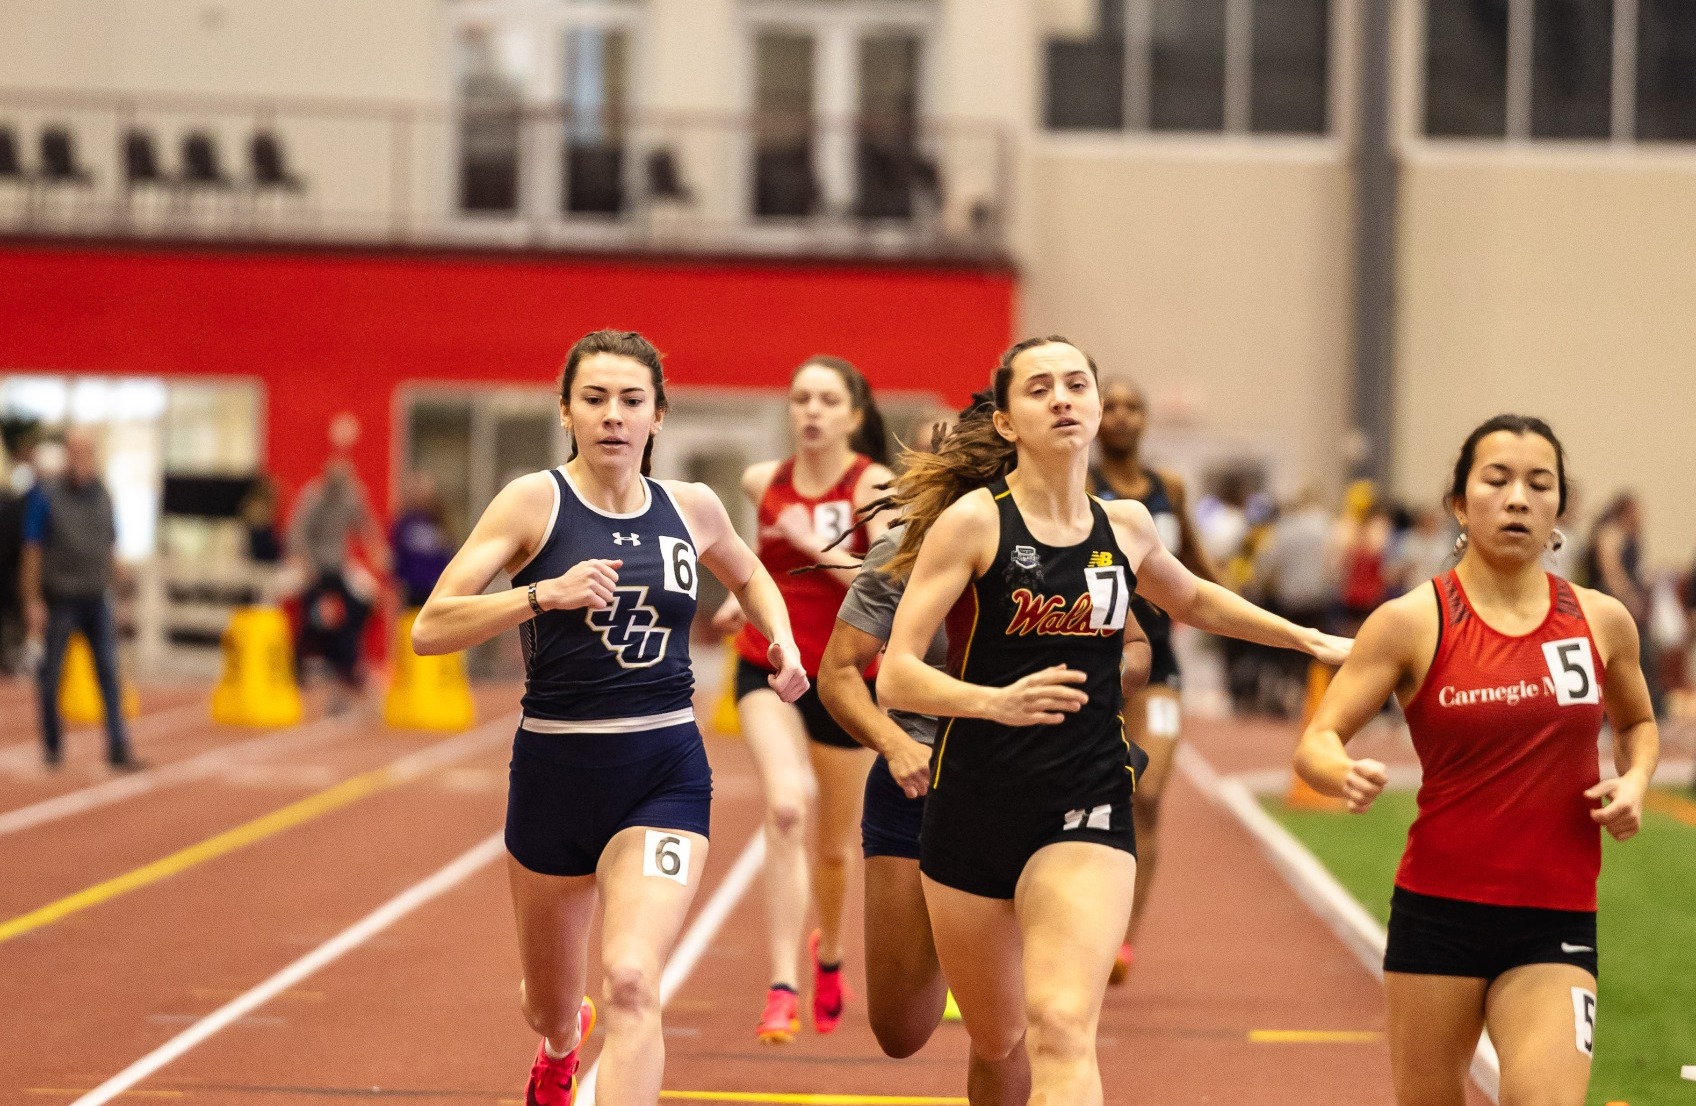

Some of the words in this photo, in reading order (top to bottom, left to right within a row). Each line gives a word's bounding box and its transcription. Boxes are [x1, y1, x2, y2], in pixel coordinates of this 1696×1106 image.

[824, 506, 841, 542] 3
[673, 542, 693, 591] 6
[1005, 588, 1117, 636] Wals
[1096, 571, 1118, 625] 7
[586, 586, 672, 668] JCU
[1439, 680, 1538, 707] Carnegie
[1557, 643, 1589, 699] 5
[655, 837, 680, 876] 6
[1584, 994, 1595, 1052] 5
